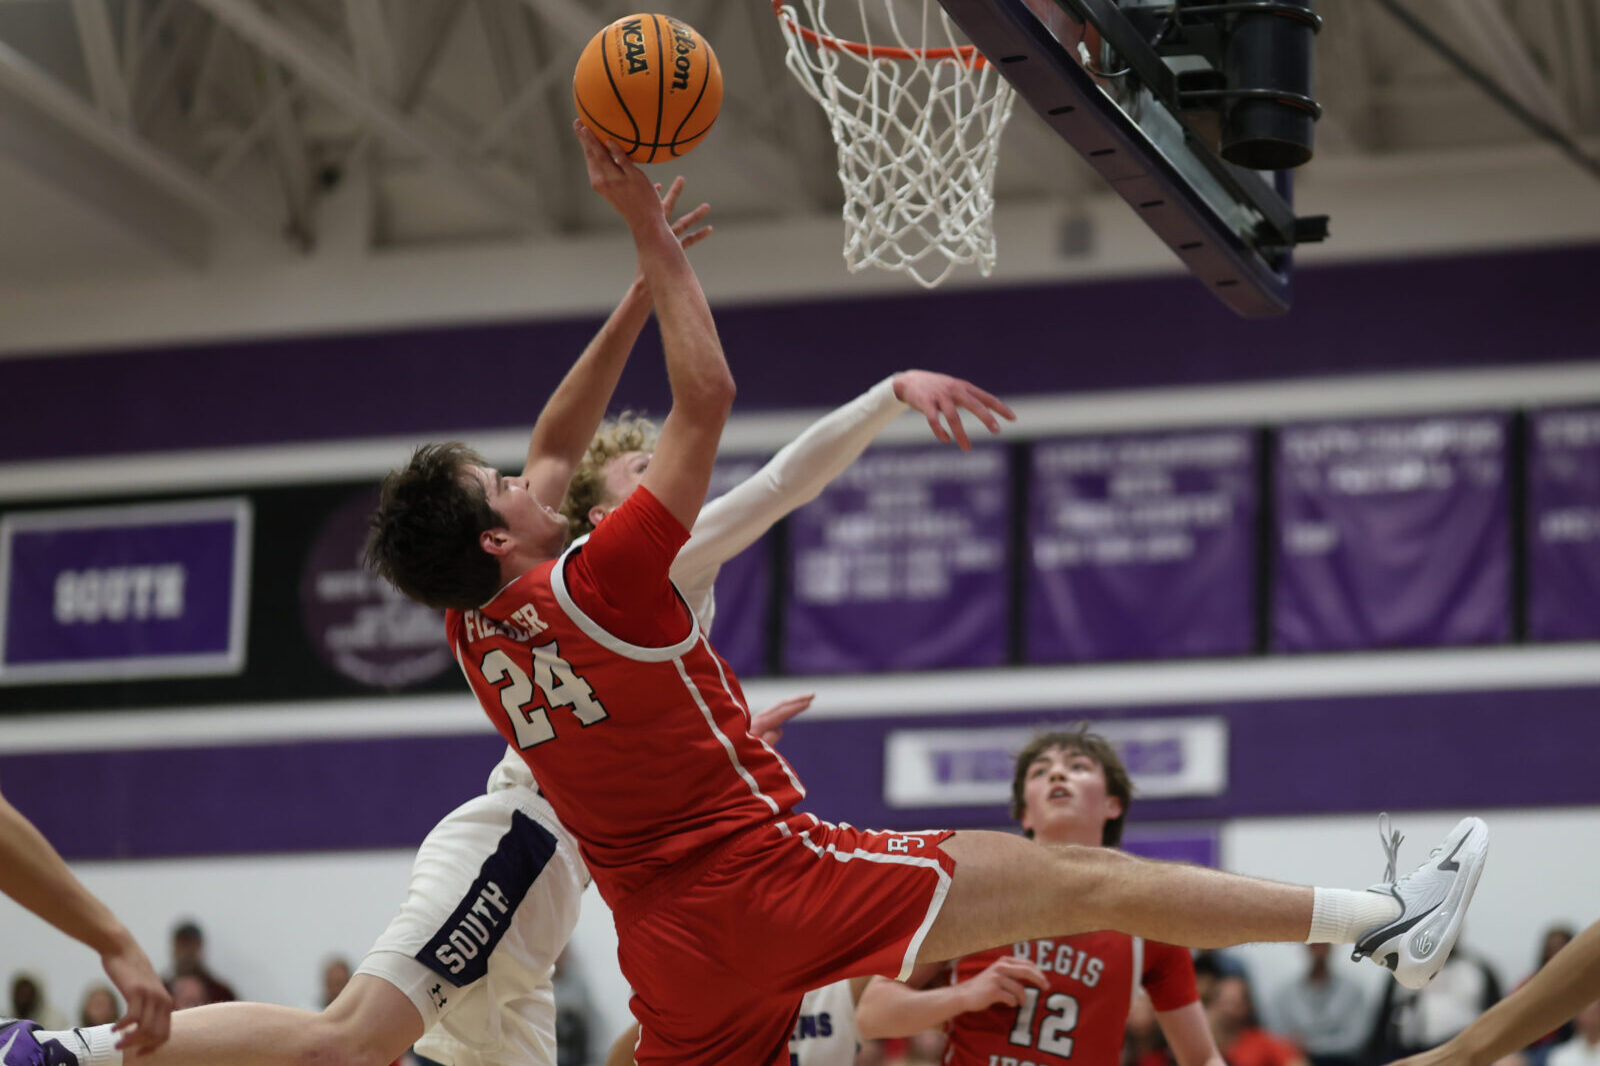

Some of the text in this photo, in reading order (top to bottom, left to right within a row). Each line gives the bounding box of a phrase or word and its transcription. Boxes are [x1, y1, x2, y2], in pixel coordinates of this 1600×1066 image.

[622, 19, 649, 75] NCAA
[53, 563, 187, 625] SOUTH
[480, 638, 611, 750] 24
[435, 880, 510, 975] SOUTH
[1012, 939, 1105, 988] REGIS
[1008, 986, 1080, 1059] 12
